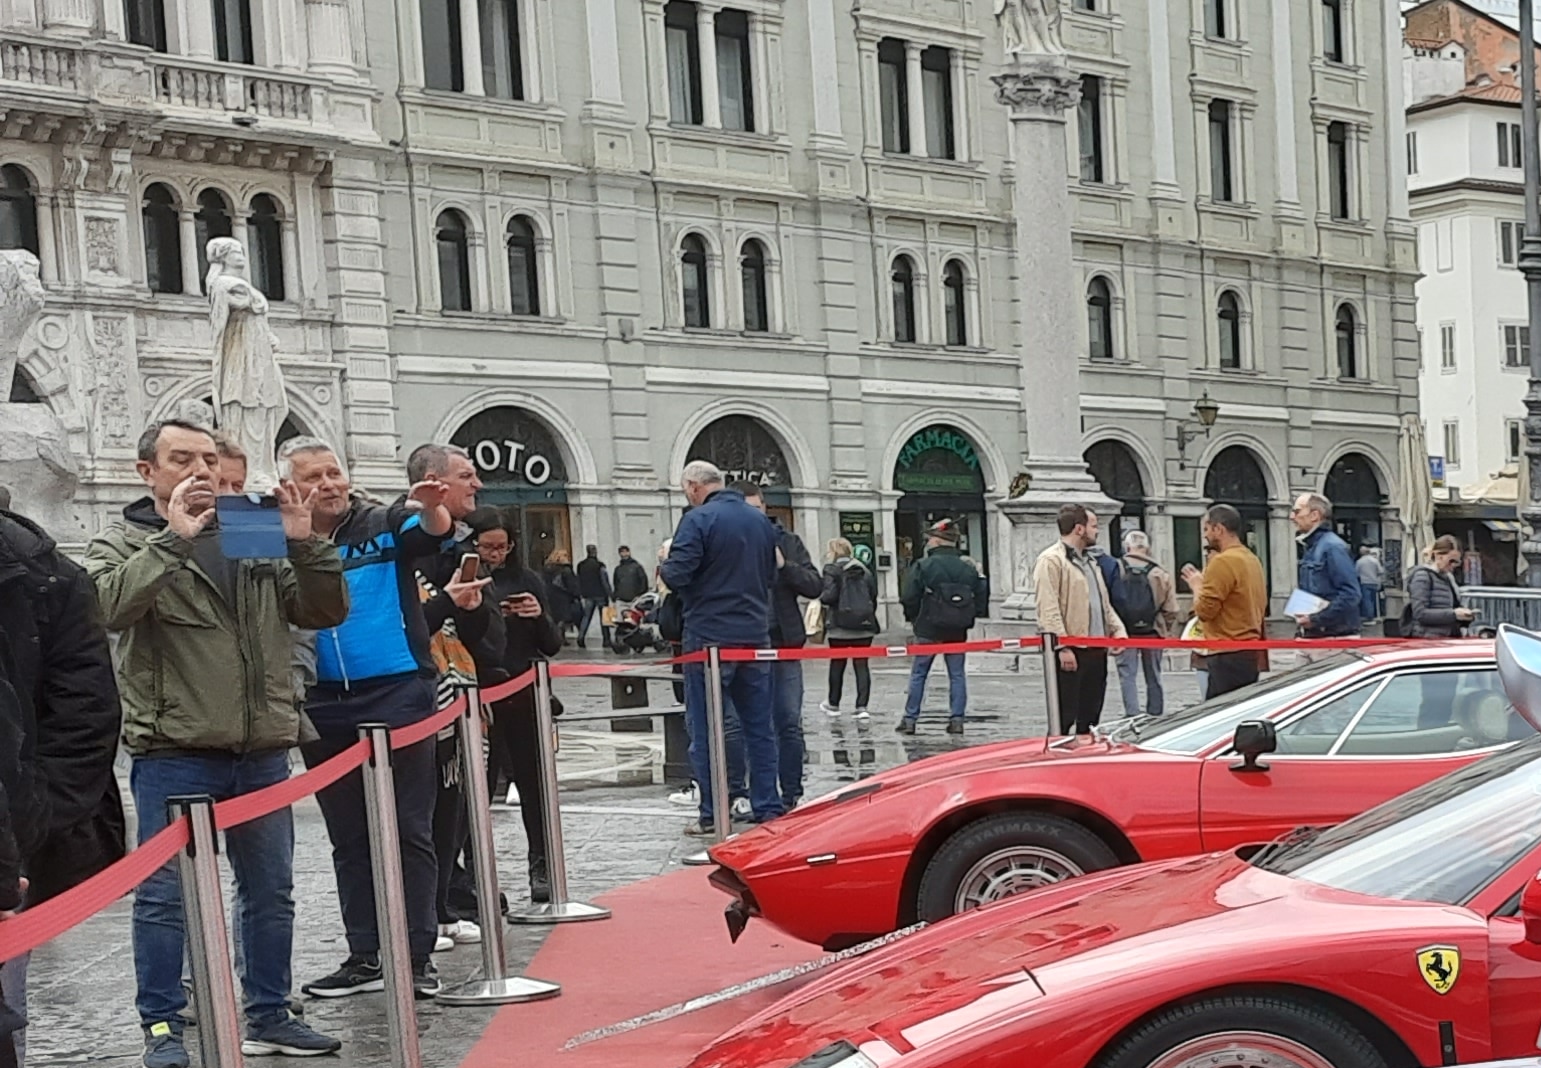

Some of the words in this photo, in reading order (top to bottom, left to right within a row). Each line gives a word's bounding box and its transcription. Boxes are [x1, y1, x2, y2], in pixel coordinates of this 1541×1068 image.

[470, 439, 551, 485] OTO
[899, 430, 979, 471] FARMACIA
[719, 469, 771, 487] TTICA
